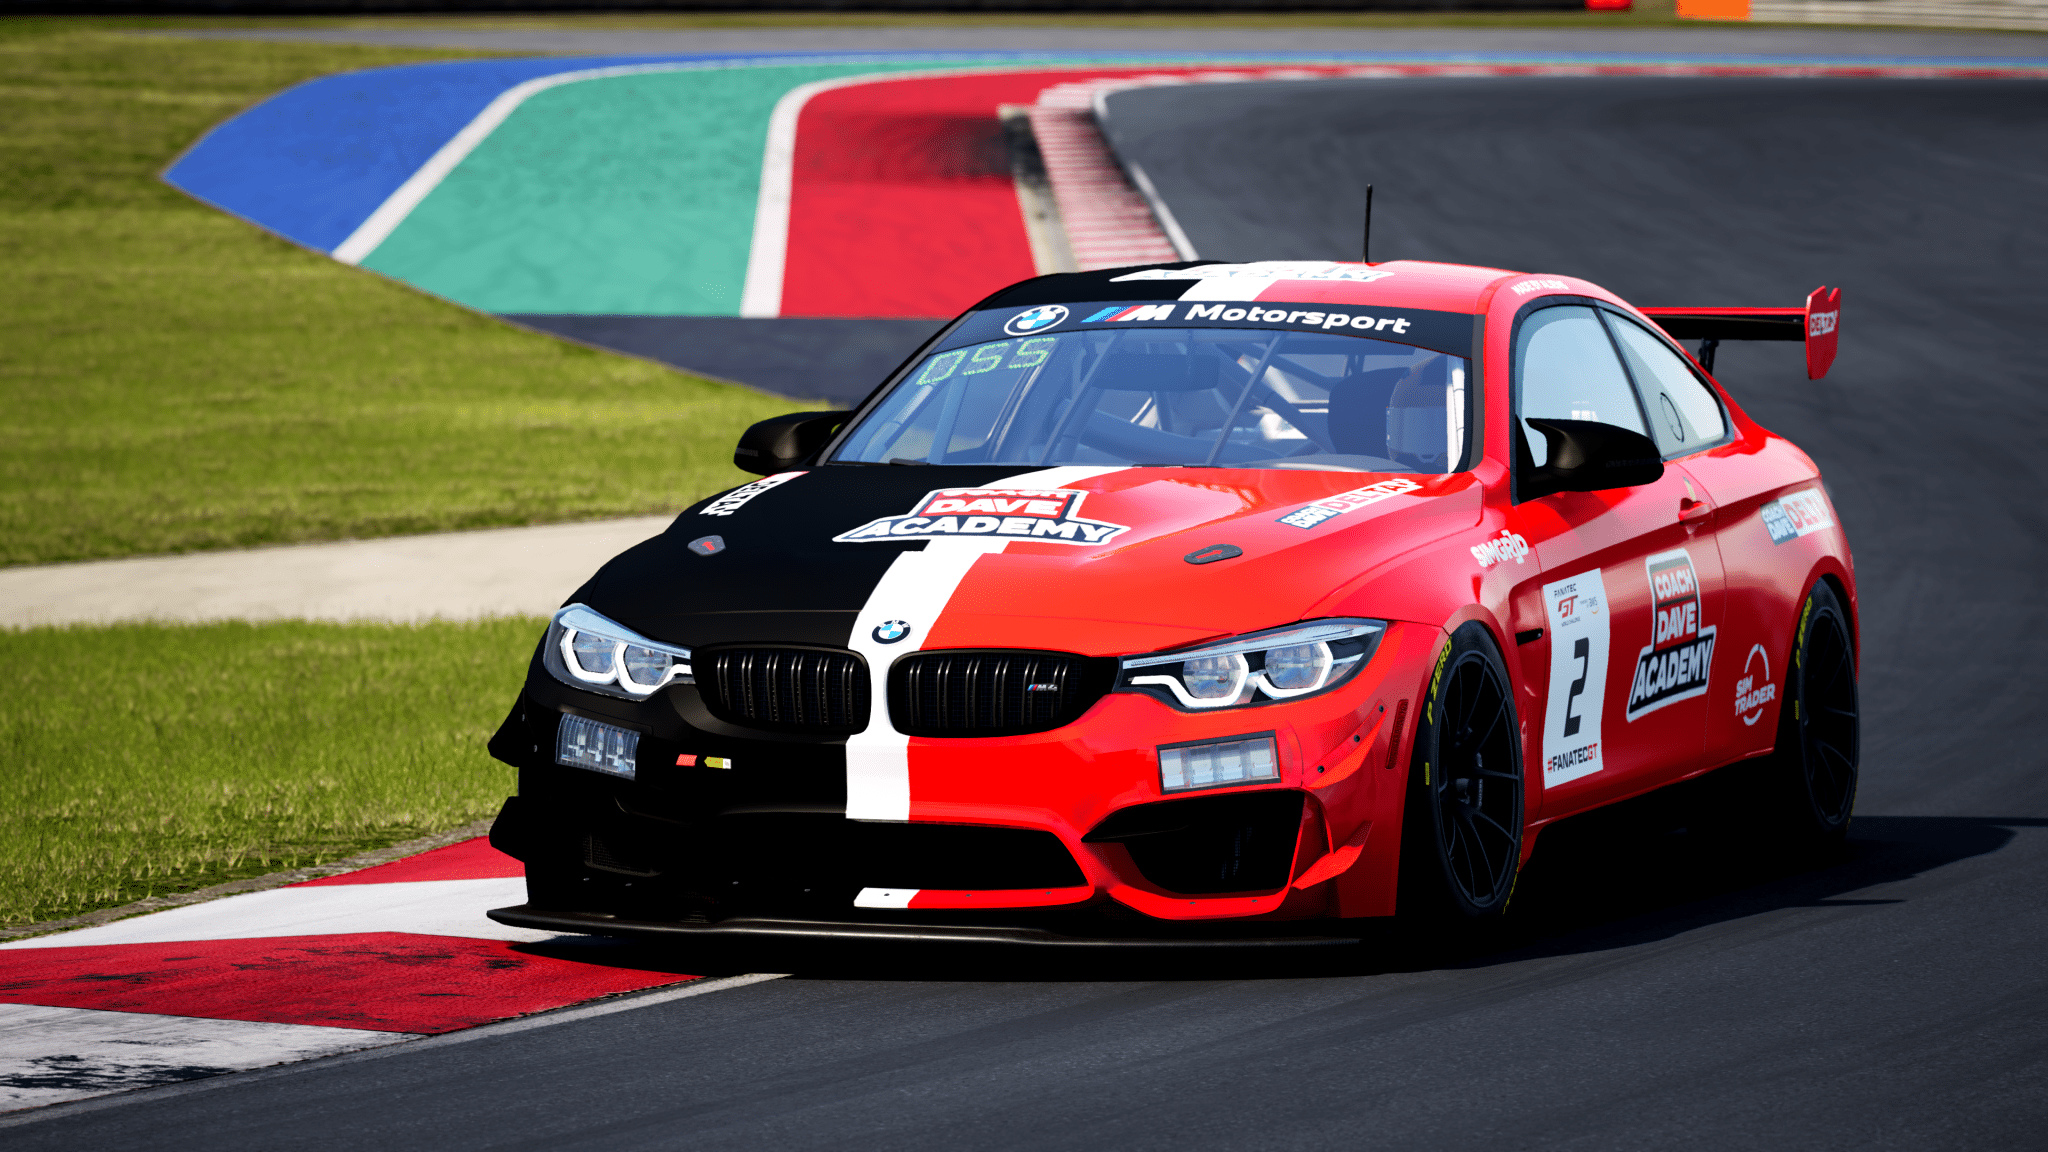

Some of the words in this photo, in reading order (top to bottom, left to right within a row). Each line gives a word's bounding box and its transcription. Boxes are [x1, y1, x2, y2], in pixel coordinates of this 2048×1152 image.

[1118, 305, 1175, 322] M
[1184, 305, 1411, 334] Motorsport
[925, 499, 1062, 515] DAVE
[850, 516, 1116, 541] ACADEMY
[1553, 583, 1577, 598] FANATEC
[1655, 568, 1694, 600] COACH
[1558, 595, 1578, 618] GT
[1656, 602, 1697, 644] DAVE
[1431, 638, 1452, 701] ZERO
[1631, 639, 1713, 705] ACADEMY
[1036, 684, 1058, 692] M4
[1564, 637, 1589, 738] 2
[1735, 683, 1776, 716] TRADER
[1736, 675, 1753, 698] SIM
[1547, 743, 1598, 774] #FANATECGT
